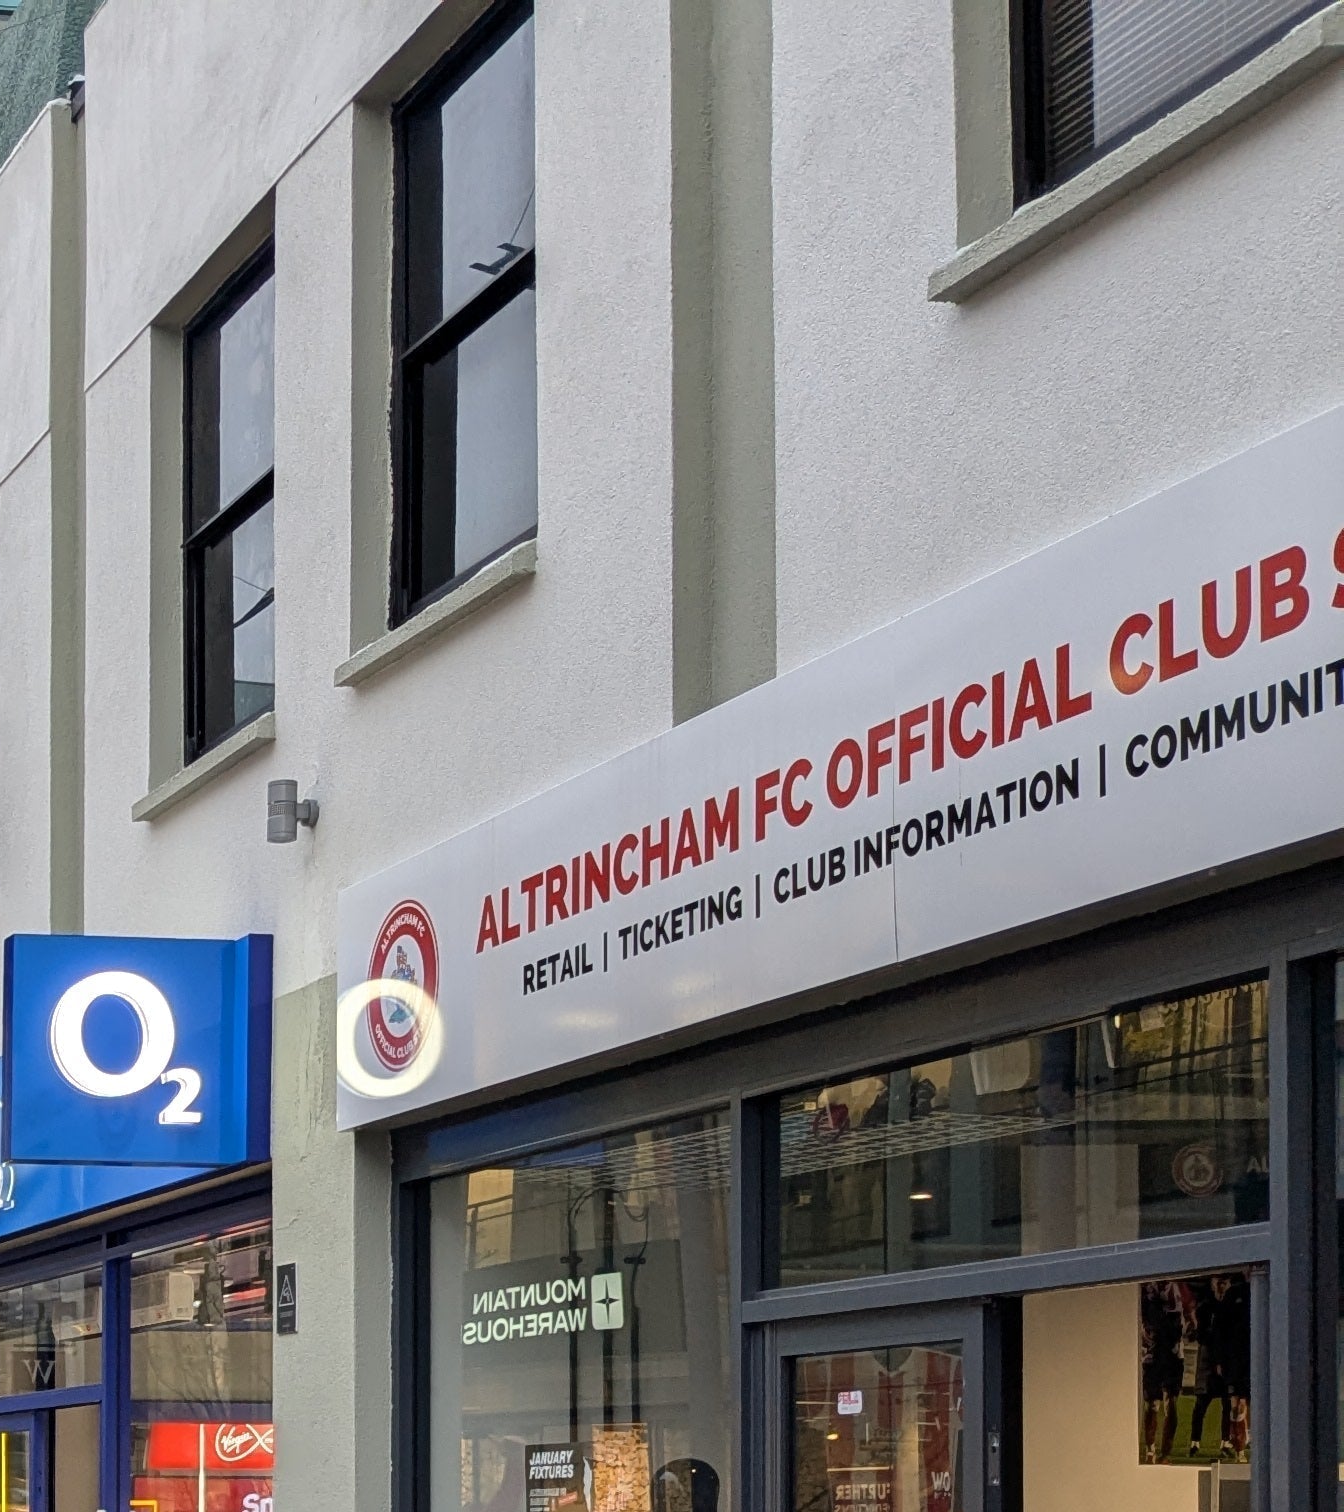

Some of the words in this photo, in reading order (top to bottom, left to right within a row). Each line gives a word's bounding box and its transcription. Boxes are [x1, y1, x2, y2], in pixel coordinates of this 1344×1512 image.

[475, 786, 740, 954] ALTRINCHAM
[755, 758, 814, 843] FC
[827, 642, 1093, 809] OFFICIAL
[1109, 545, 1310, 695] CLUB
[522, 942, 594, 996] RETAIL
[618, 885, 743, 961] TICKETING
[773, 846, 847, 904] CLUB
[854, 757, 1080, 878] INFORMATION
[48, 971, 202, 1125] O2
[220, 1426, 254, 1453] Virgin
[529, 1450, 574, 1466] JANUARY
[529, 1464, 574, 1480] FIXTURES
